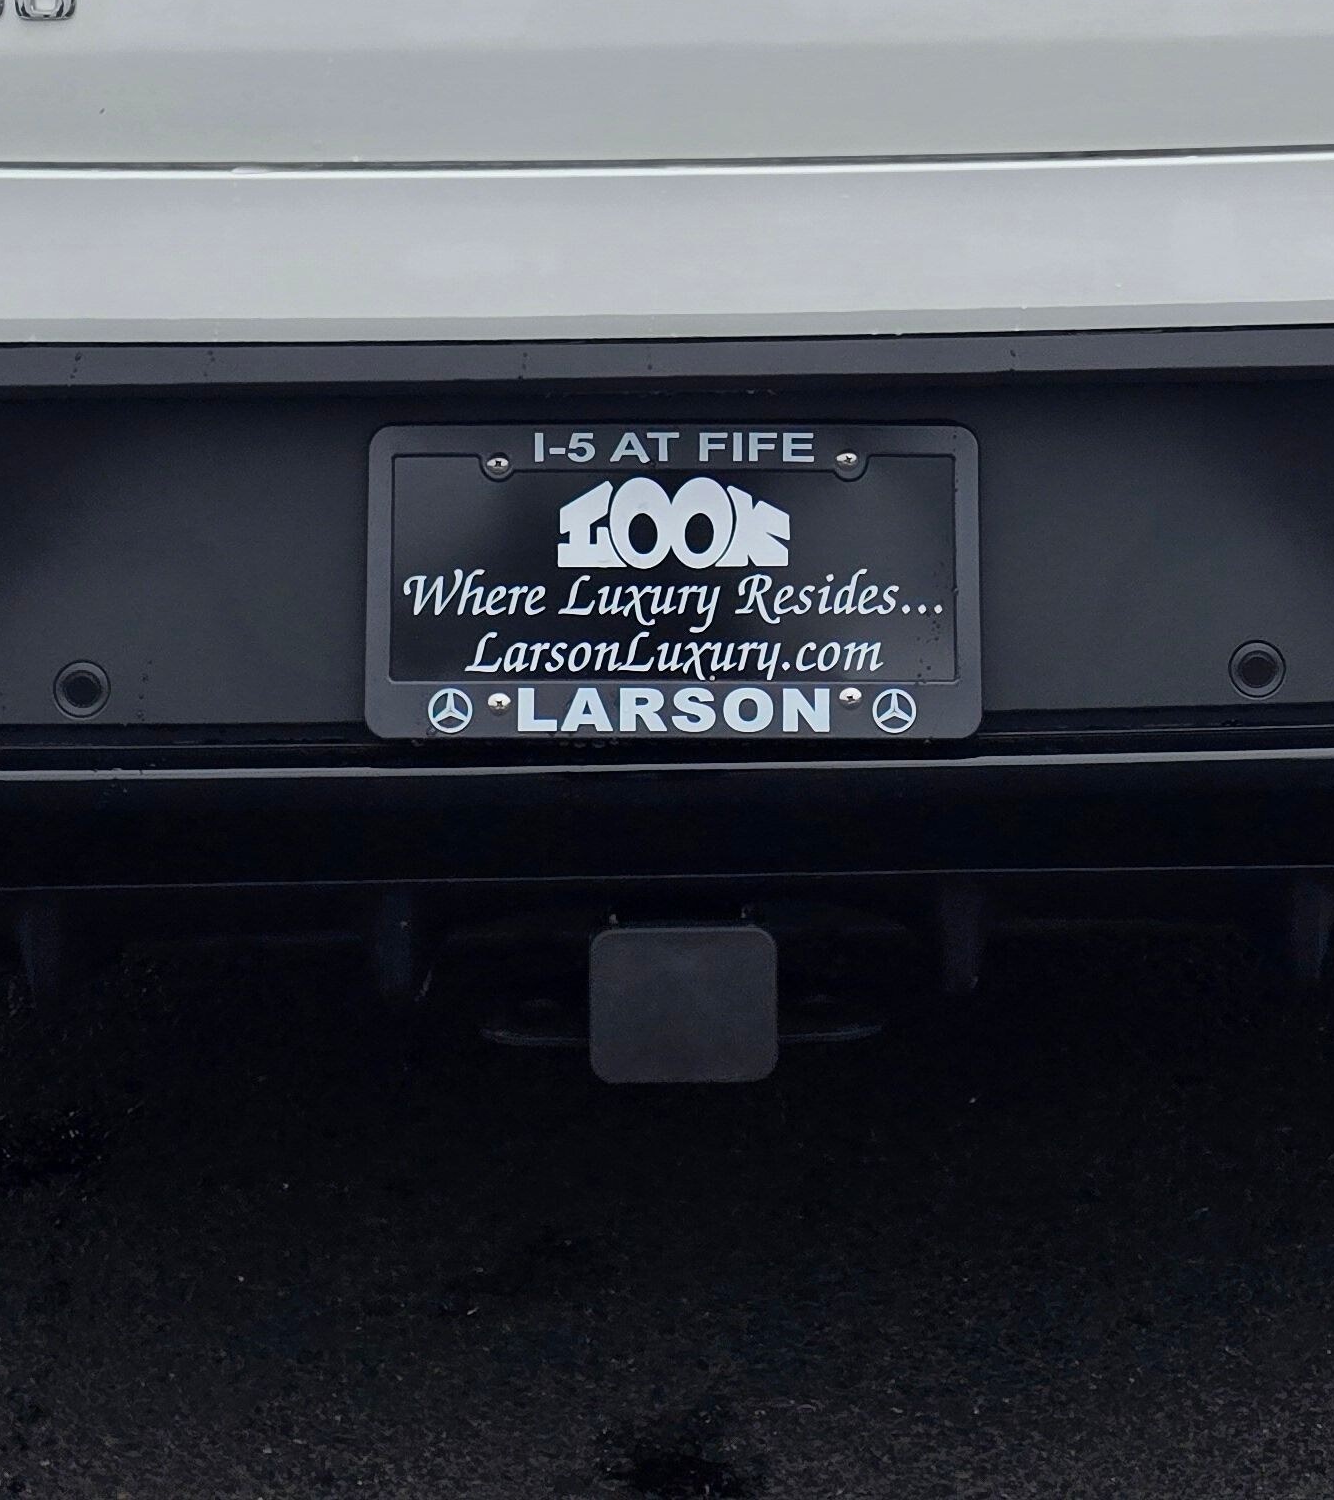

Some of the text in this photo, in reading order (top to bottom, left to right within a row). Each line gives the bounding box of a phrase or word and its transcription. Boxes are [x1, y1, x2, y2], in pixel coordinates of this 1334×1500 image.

[533, 431, 816, 463] I-5 AT FIFE
[402, 567, 944, 633] Where Luxury Resides...
[464, 631, 884, 681] LarsonLuxury.com
[517, 687, 831, 733] LARSON
